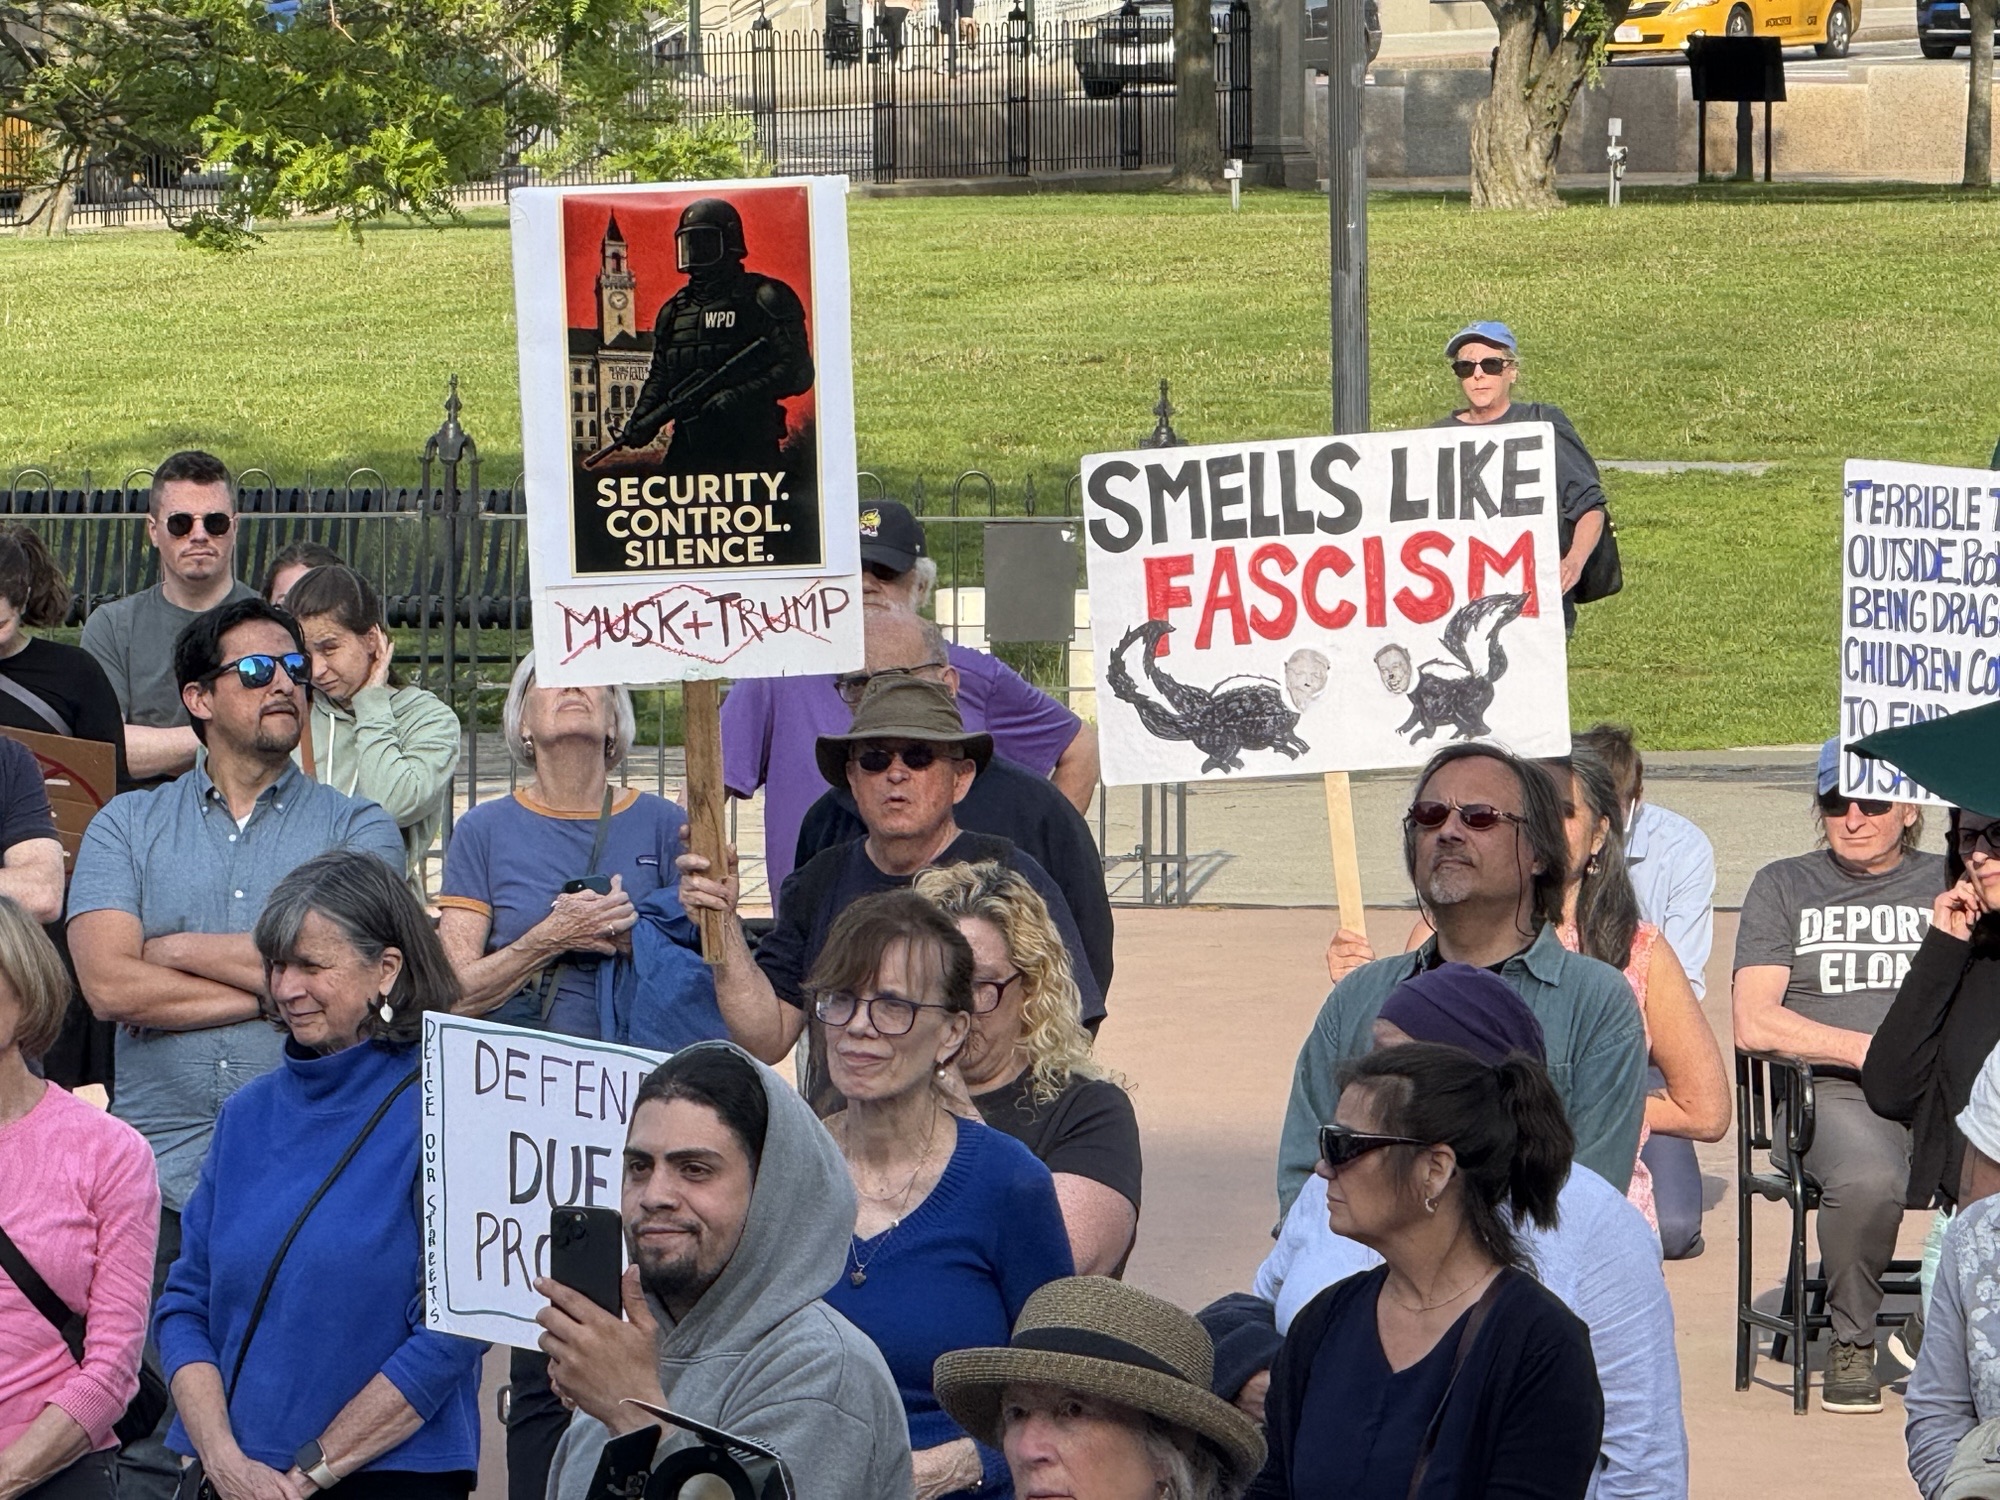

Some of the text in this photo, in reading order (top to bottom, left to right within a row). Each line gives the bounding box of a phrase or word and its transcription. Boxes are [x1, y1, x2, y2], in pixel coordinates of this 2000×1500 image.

[705, 311, 736, 329] WPD
[596, 471, 790, 508] SECURITY.
[1088, 435, 1545, 553] SMELLS LIKE
[1847, 479, 1982, 531] TERRIBLE
[606, 504, 792, 538] CONTROL.
[625, 535, 775, 567] SILENCE.
[1847, 534, 1962, 586] OUTSIDE
[1143, 530, 1540, 658] FASCISM
[1848, 586, 2000, 638] BEING DRAG
[1843, 636, 1961, 694] CHILDREN
[1843, 695, 1878, 738] TO
[474, 1039, 650, 1125] DEFEN
[509, 1130, 613, 1209] DUE
